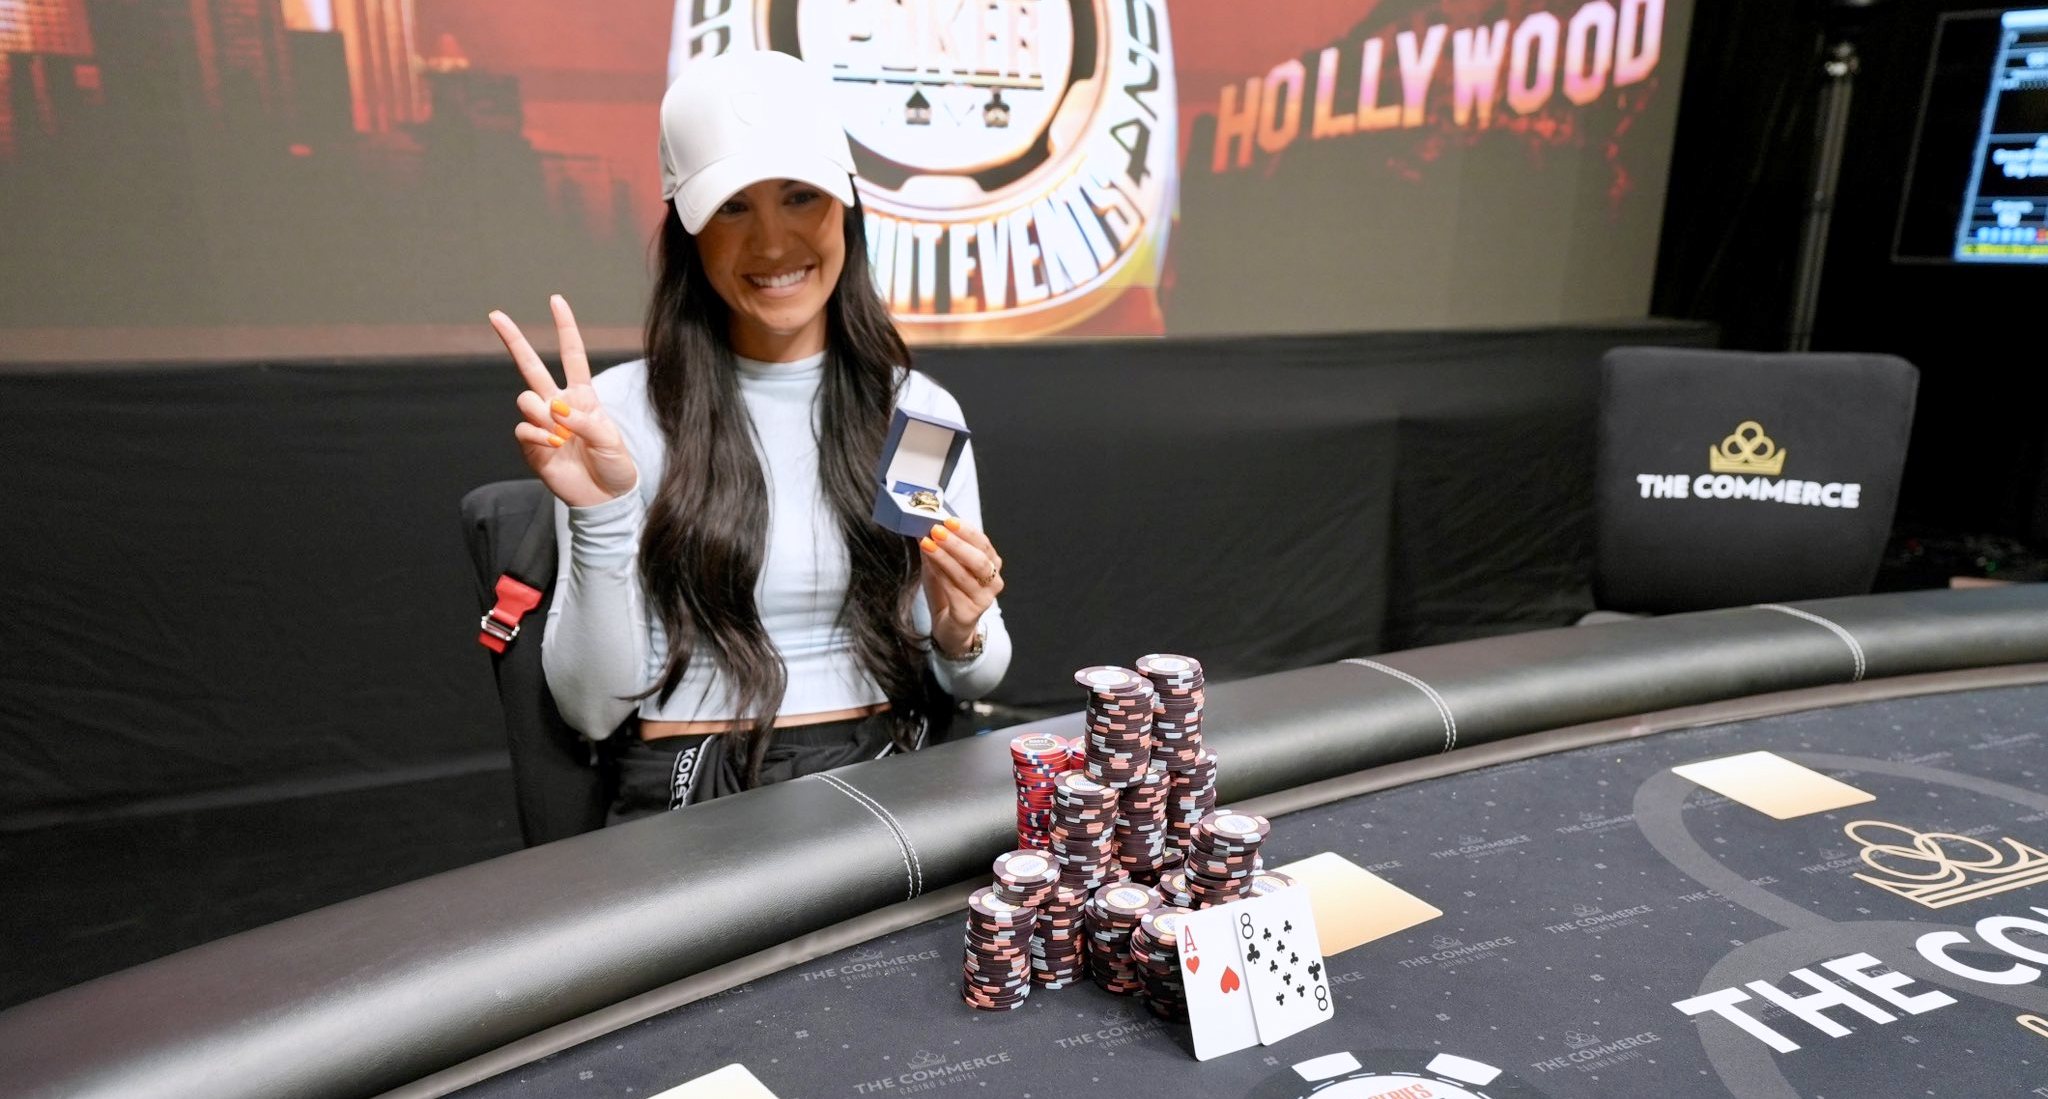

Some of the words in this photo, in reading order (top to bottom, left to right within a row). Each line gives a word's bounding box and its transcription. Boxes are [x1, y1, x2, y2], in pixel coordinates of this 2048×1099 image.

[1211, 0, 1666, 173] HOLLYWOOD
[947, 168, 1146, 314] EVENTS
[1636, 474, 1690, 499] THE
[1693, 474, 1861, 508] COMMERCE
[675, 747, 697, 799] KORS
[1430, 848, 1460, 860] THE
[1240, 913, 1254, 940] 8
[1544, 922, 1578, 934] THE
[1575, 904, 1654, 927] COMMERCE
[1183, 925, 1198, 953] A
[1398, 954, 1433, 969] THE
[1432, 936, 1517, 962] COMMERCE
[799, 967, 838, 982] THE
[840, 949, 941, 975] COMMERCE
[1314, 985, 1328, 1011] 8
[1671, 951, 1959, 1054] THE
[1054, 1033, 1095, 1049] THE
[1531, 1057, 1571, 1072] THE
[1568, 1031, 1661, 1063] COMMERCE
[853, 1077, 896, 1094] THE
[899, 1052, 1011, 1084] COMMERCE
